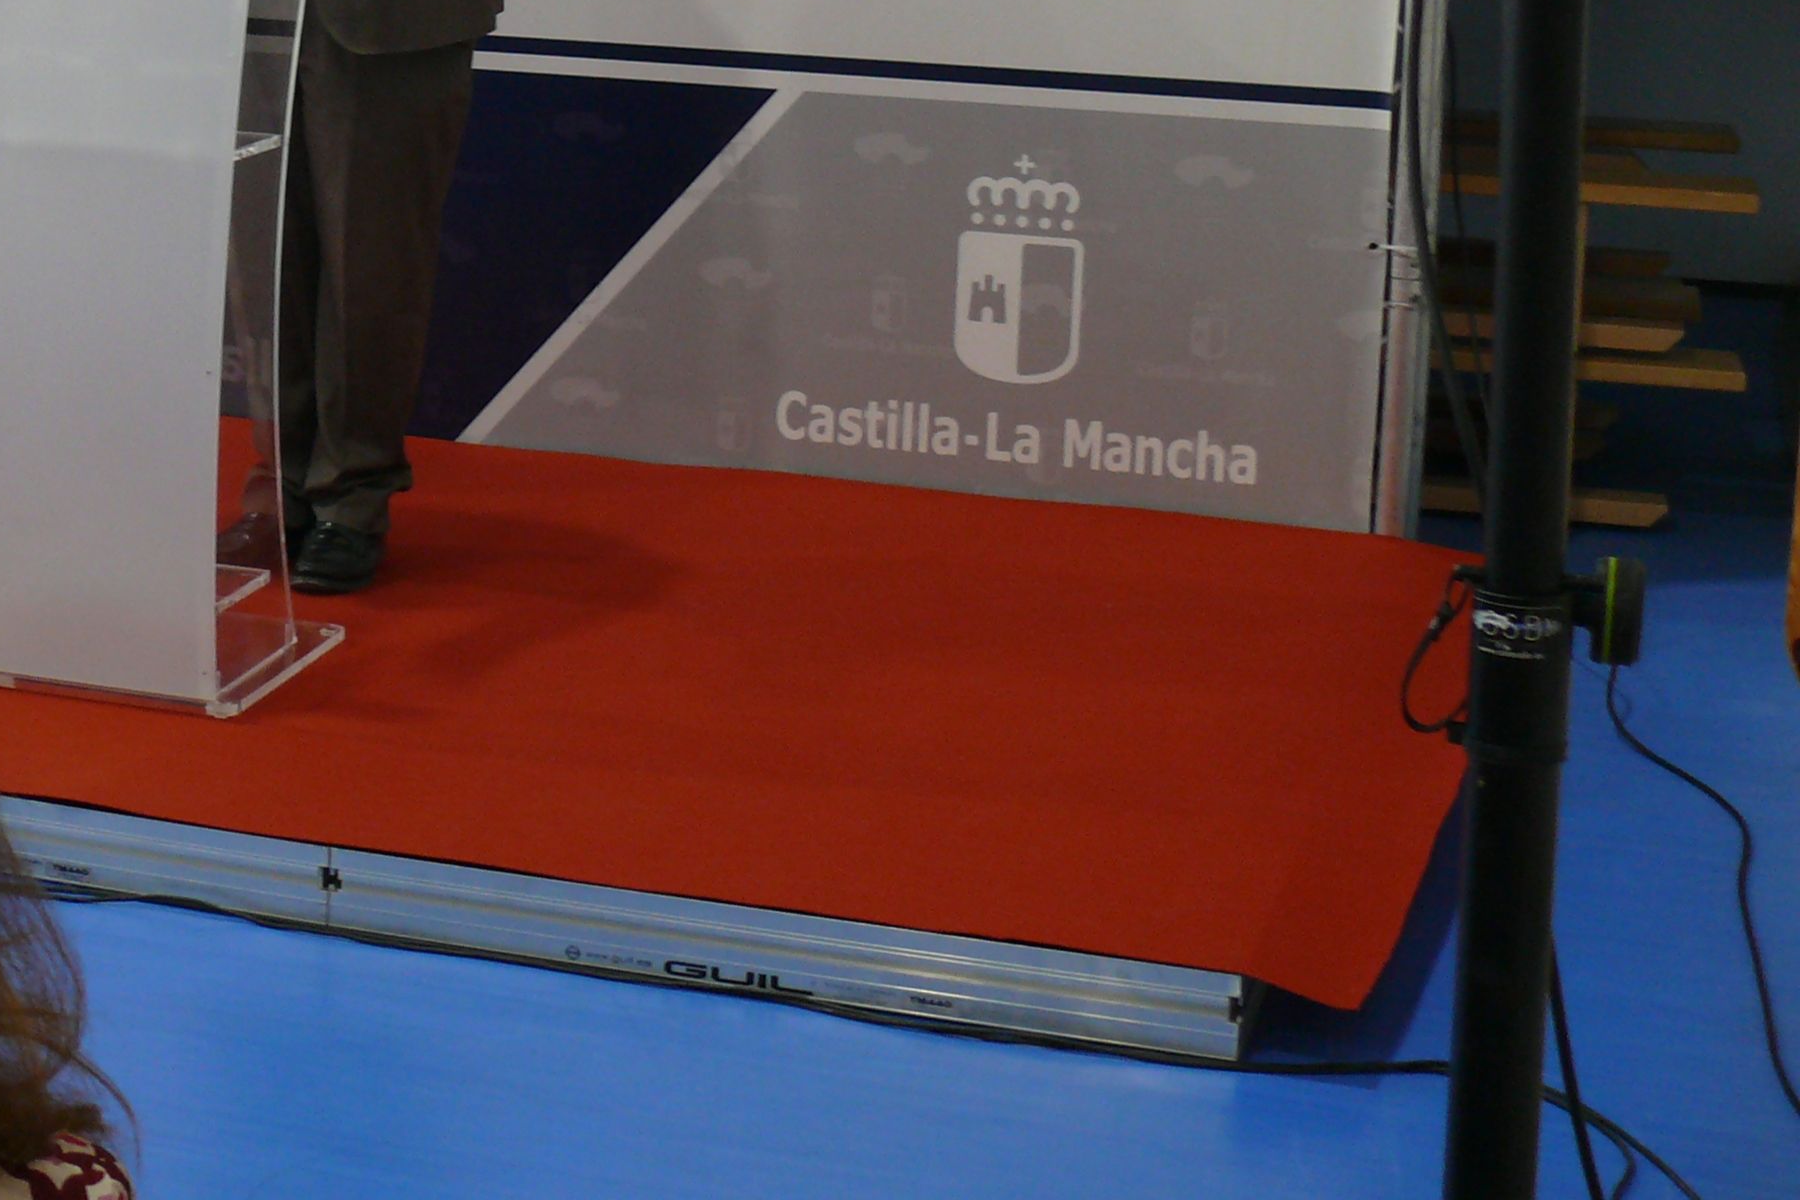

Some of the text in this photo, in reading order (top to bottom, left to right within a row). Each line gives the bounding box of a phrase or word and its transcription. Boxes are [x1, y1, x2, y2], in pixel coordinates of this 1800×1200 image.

[775, 390, 1258, 485] Castilla-La Mancha
[663, 959, 814, 996] GUIL
